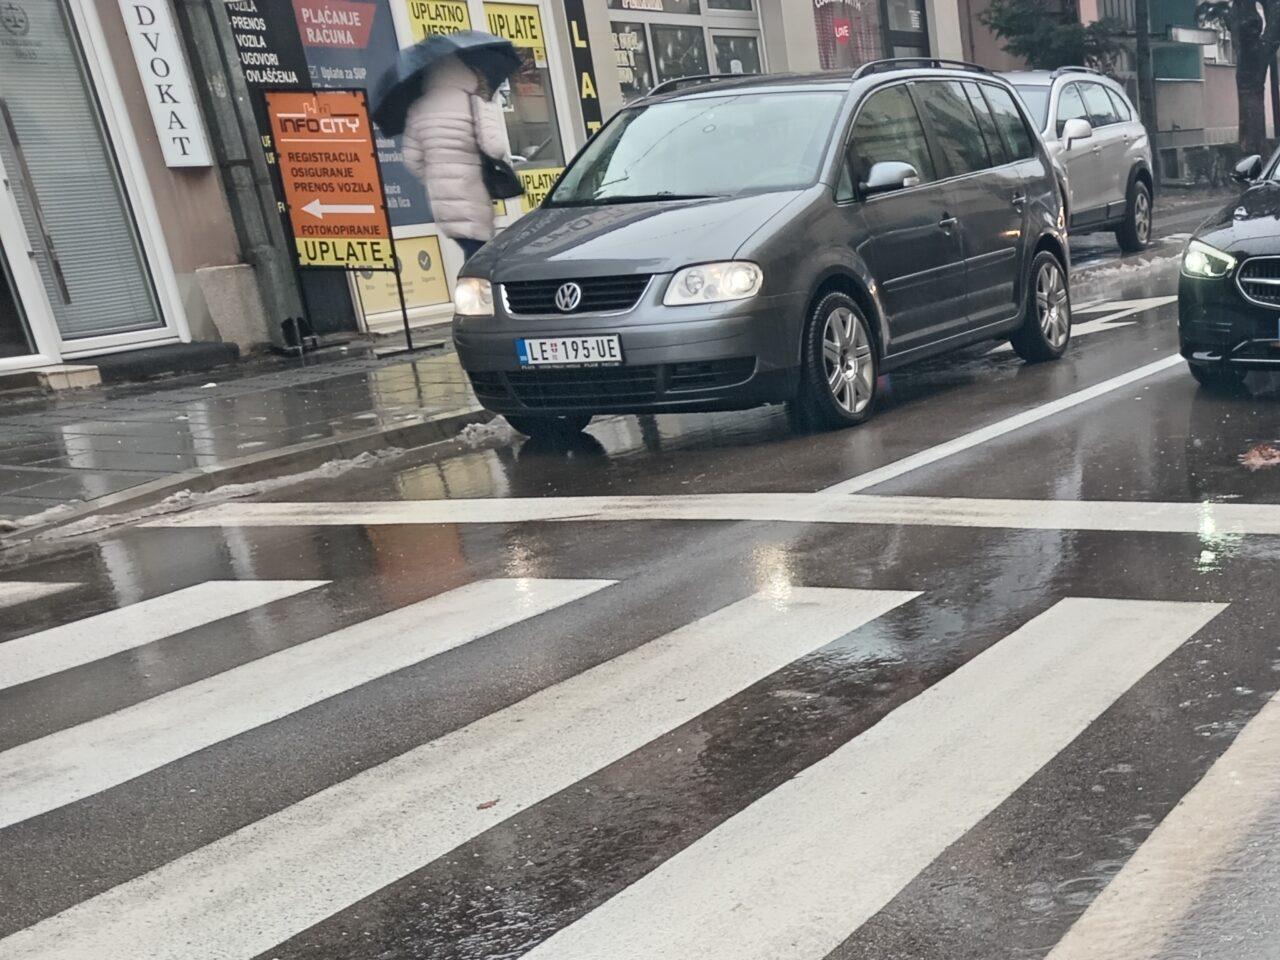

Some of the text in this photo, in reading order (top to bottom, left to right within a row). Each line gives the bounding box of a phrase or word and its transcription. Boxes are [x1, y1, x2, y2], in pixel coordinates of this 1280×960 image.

[411, 2, 464, 23] UPLATNO
[488, 14, 538, 39] UPLATE
[235, 33, 267, 48] VOZILA
[279, 118, 360, 133] INFOCITY
[288, 152, 360, 163] REGISTRACIJA
[291, 167, 354, 177] OSIGURANJE
[294, 182, 374, 193] PRENOS VOZILA
[301, 225, 380, 236] FOTOKOPIRANJE
[304, 241, 384, 262] UPLATE
[529, 342, 549, 361] LE
